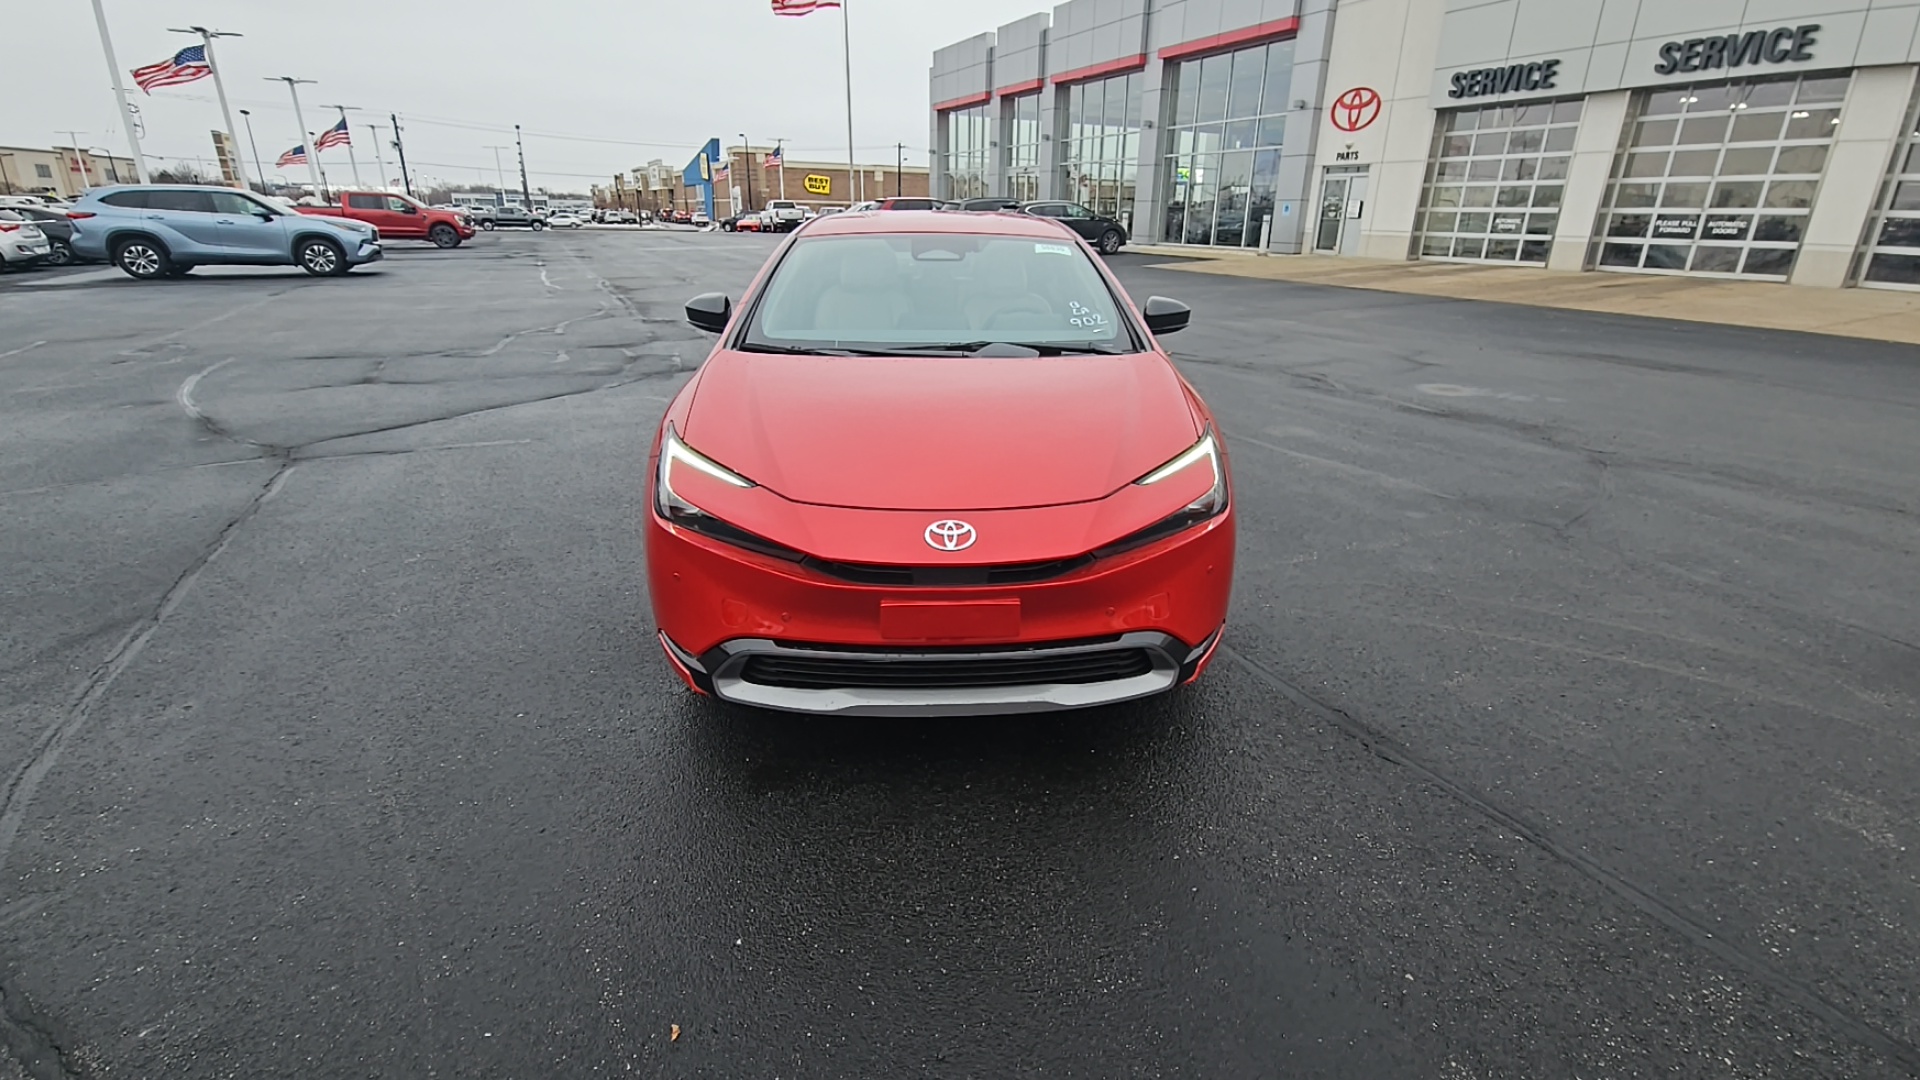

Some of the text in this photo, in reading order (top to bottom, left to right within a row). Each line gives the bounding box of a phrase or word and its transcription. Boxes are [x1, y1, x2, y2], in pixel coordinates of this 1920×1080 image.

[1655, 24, 1819, 75] SERVICE
[1449, 59, 1560, 98] SERVICE
[1336, 151, 1359, 161] PARTS
[1069, 314, 1109, 328] 902
